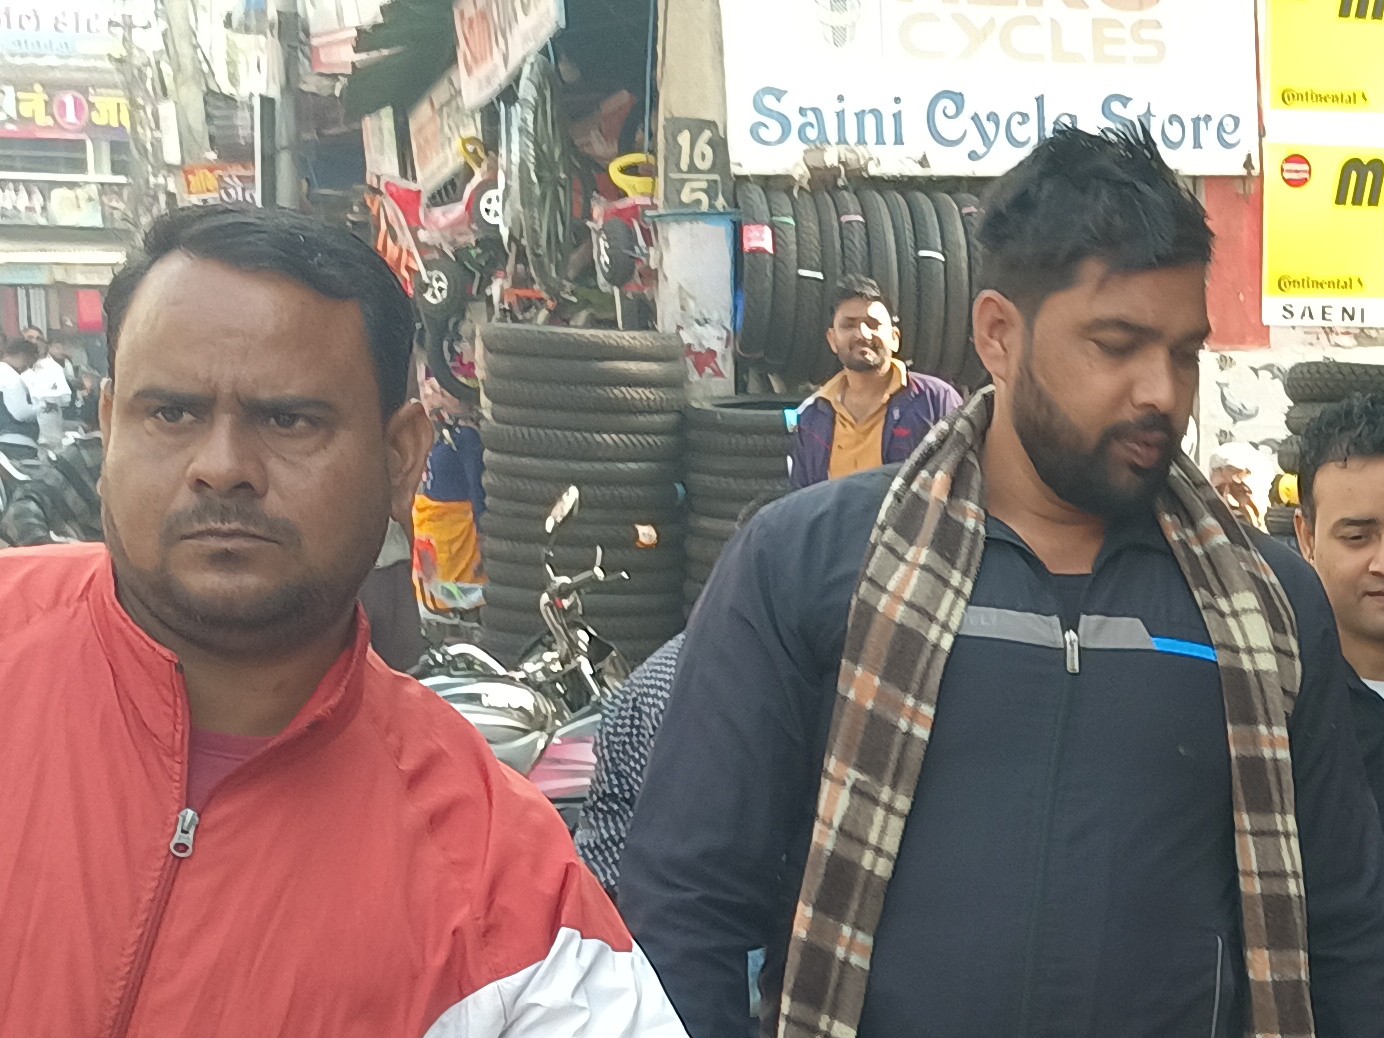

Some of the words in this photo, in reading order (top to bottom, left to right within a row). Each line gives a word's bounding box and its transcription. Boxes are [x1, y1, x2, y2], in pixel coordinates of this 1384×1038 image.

[899, 12, 1167, 64] CYCLES
[749, 86, 905, 147] Saini
[1100, 93, 1241, 151] Store
[677, 129, 713, 172] 16
[680, 181, 709, 212] 5
[1277, 275, 1353, 293] Continental
[1282, 303, 1365, 324] SAENI
